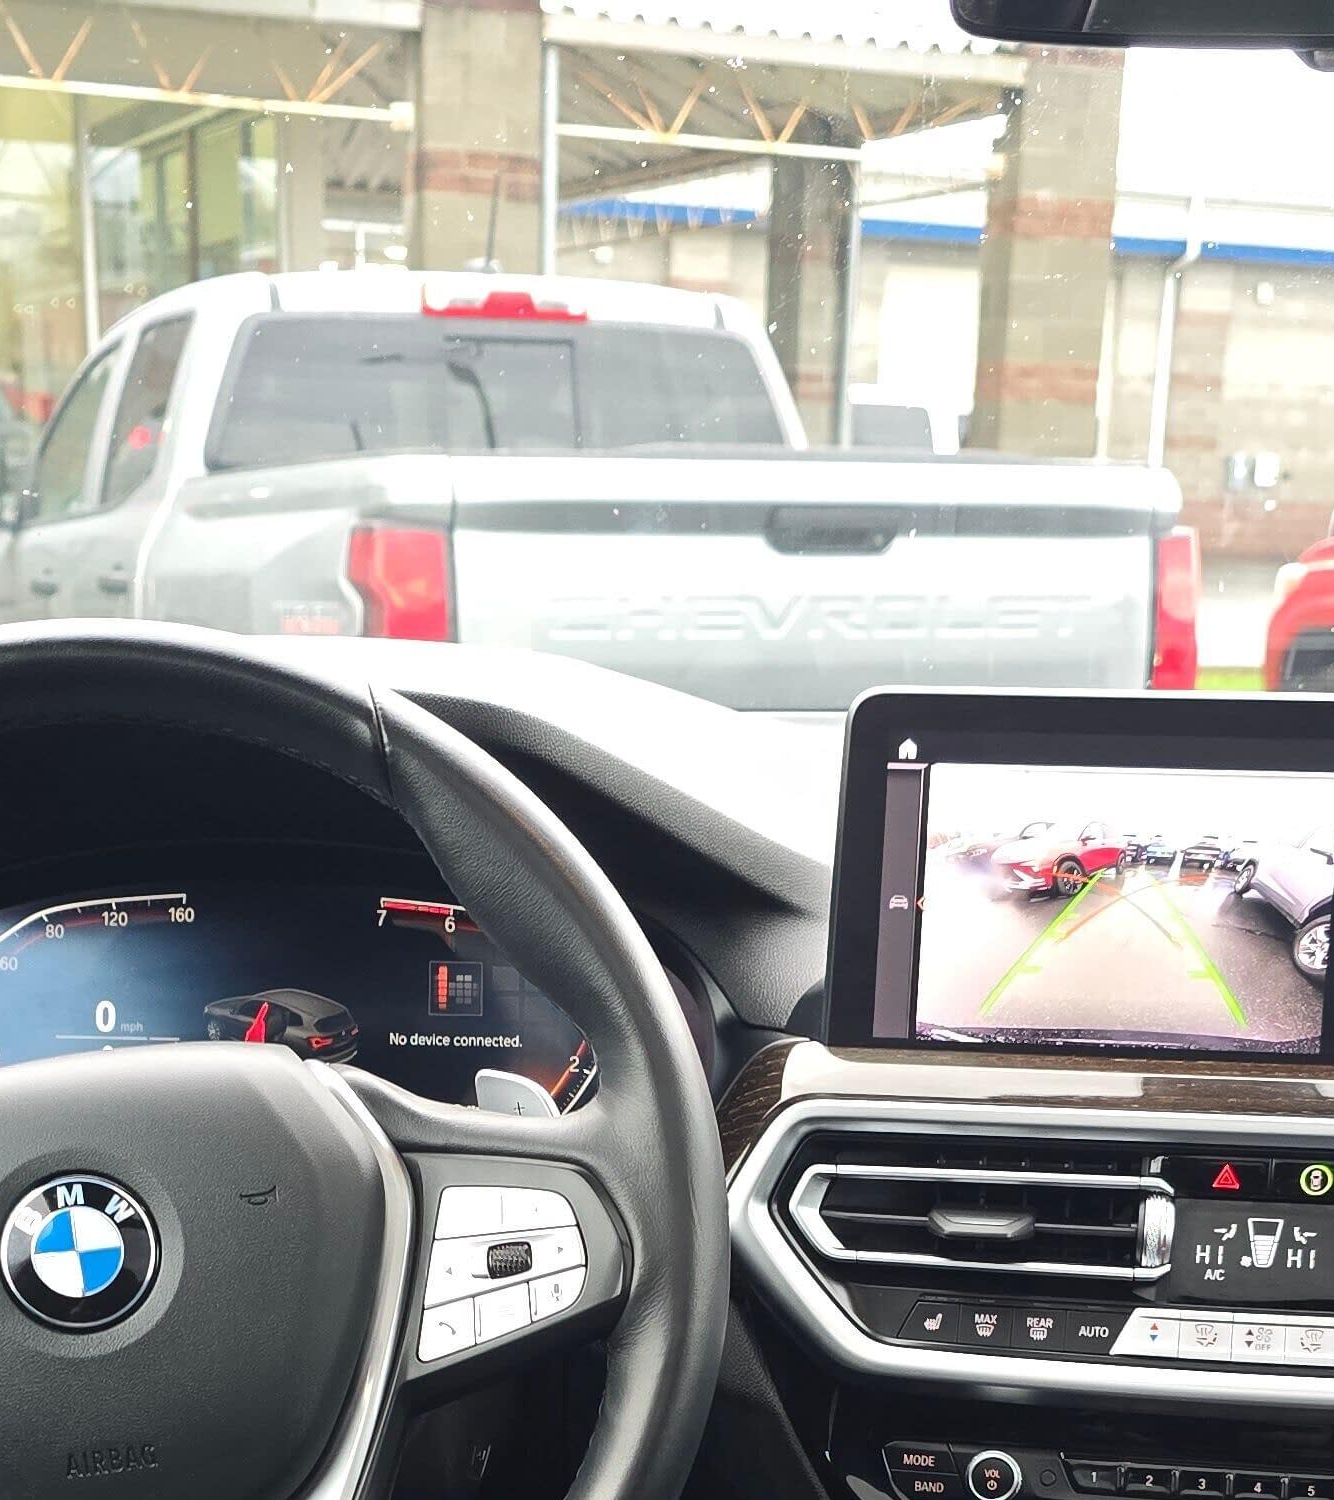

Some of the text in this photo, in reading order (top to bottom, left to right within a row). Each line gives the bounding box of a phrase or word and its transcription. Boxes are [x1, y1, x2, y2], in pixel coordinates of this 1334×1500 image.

[548, 594, 1095, 641] CHEVROLET
[101, 911, 129, 928] 120
[167, 906, 195, 923] 160
[376, 910, 387, 927] 7
[44, 923, 65, 939] 80
[444, 917, 457, 932] 6
[95, 1000, 144, 1034] 0 mph
[389, 1032, 523, 1048] No device connected.
[568, 1056, 580, 1073] 2
[14, 1183, 136, 1236] BMW
[1204, 1268, 1226, 1281] A/C
[973, 1314, 998, 1326] MAX
[1026, 1317, 1054, 1329] REAR
[1078, 1325, 1109, 1339] AUTO
[1254, 1342, 1272, 1351] OFF
[67, 1444, 159, 1480] AIRBAG
[903, 1453, 935, 1468] MODE
[984, 1468, 1001, 1480] VOL
[1090, 1470, 1097, 1483] 1
[1145, 1473, 1154, 1487] 2
[914, 1480, 944, 1494] BAND
[1197, 1477, 1207, 1491] 3
[1253, 1481, 1263, 1494] 4
[1307, 1484, 1316, 1497] 5
